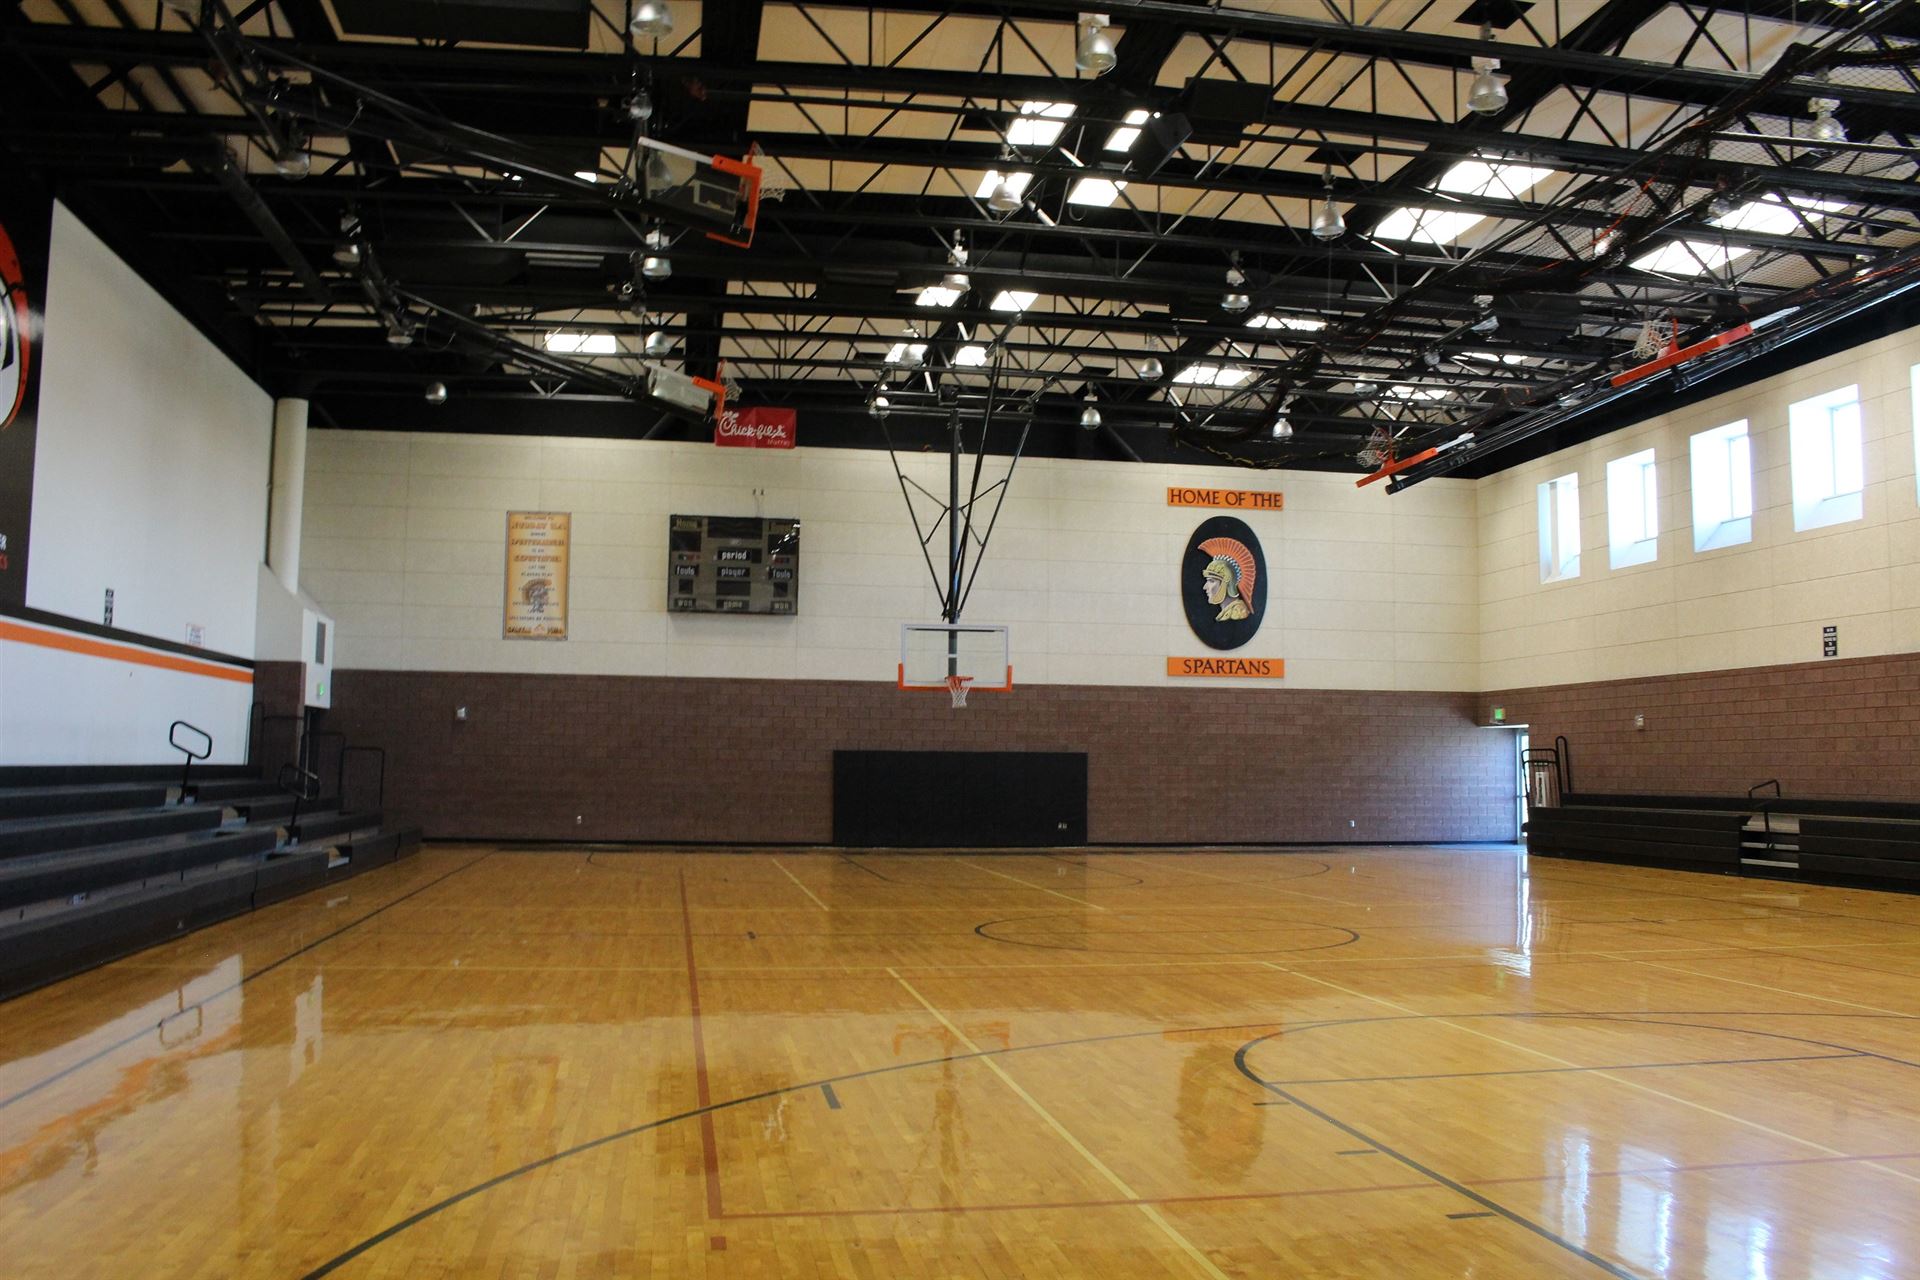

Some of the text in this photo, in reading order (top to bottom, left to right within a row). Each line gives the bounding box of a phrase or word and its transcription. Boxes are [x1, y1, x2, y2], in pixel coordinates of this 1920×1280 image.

[1170, 489, 1282, 508] HOME OF THE
[721, 550, 747, 560] period
[721, 567, 746, 577] player
[1183, 659, 1271, 676] SPARTANS
